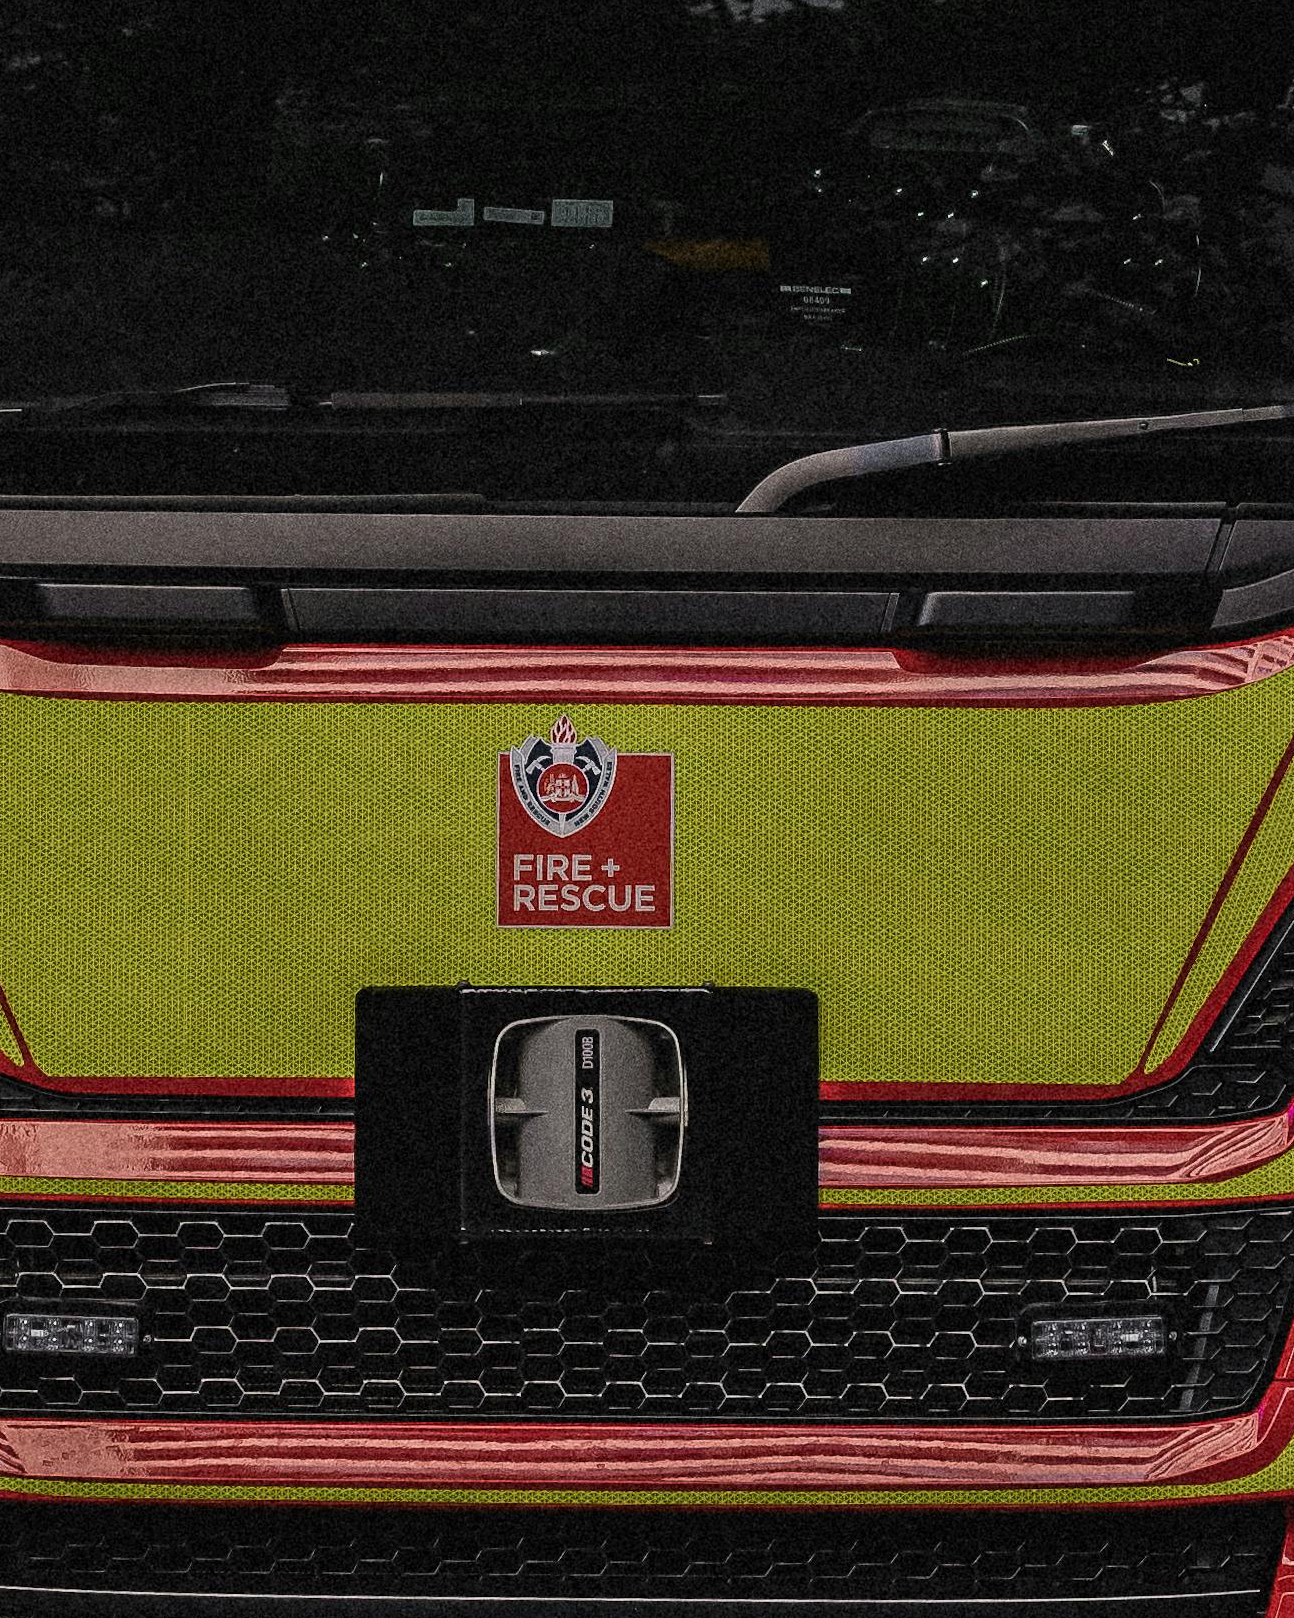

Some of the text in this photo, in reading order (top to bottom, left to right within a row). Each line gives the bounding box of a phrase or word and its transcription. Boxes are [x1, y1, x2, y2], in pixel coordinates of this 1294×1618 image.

[513, 854, 592, 881] FIRE
[513, 884, 655, 912] RESCUE
[581, 1087, 594, 1104] 3
[581, 1106, 594, 1167] CODE
